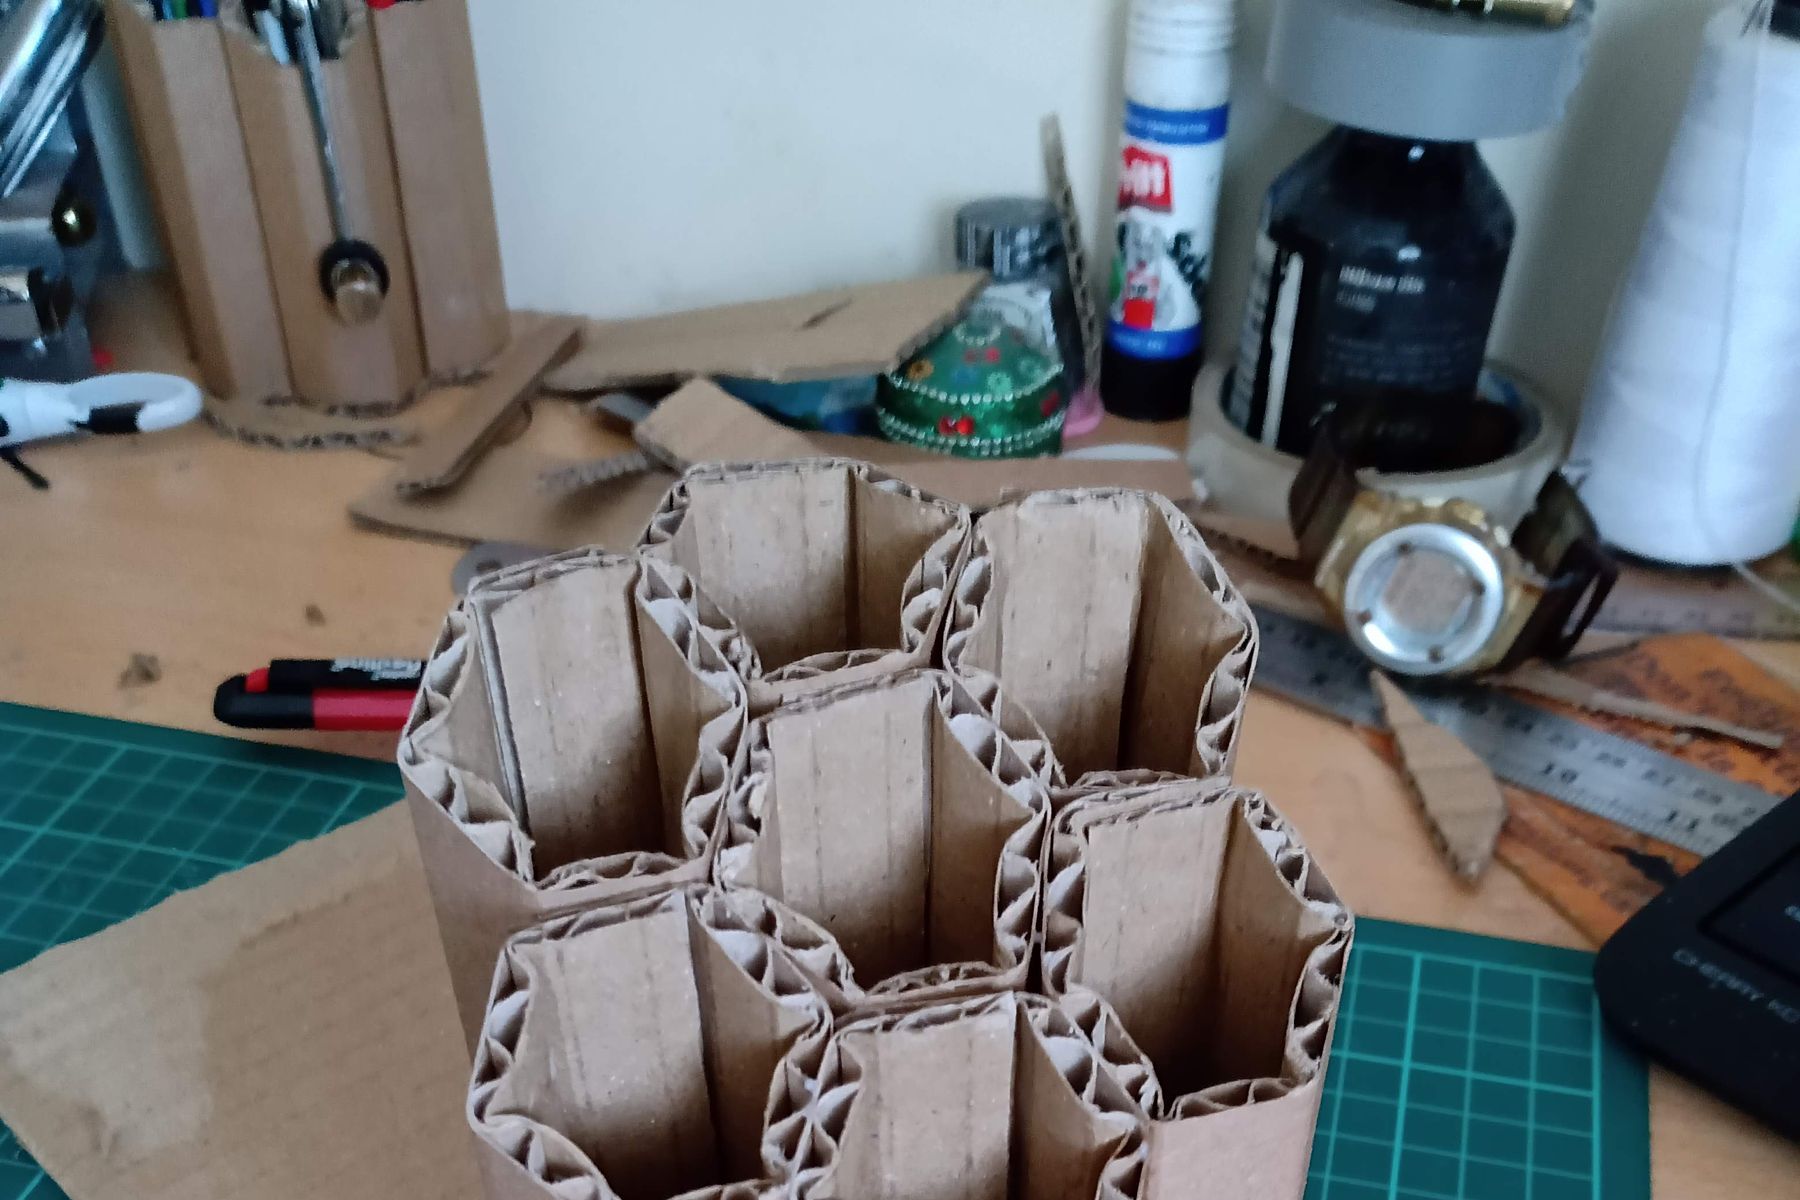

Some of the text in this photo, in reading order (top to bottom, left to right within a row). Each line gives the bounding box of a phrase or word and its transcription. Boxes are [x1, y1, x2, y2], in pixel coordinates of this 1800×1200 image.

[1543, 760, 1579, 785] 10
[1665, 809, 1700, 833] 11
[1671, 948, 1764, 1002] CHERRY
